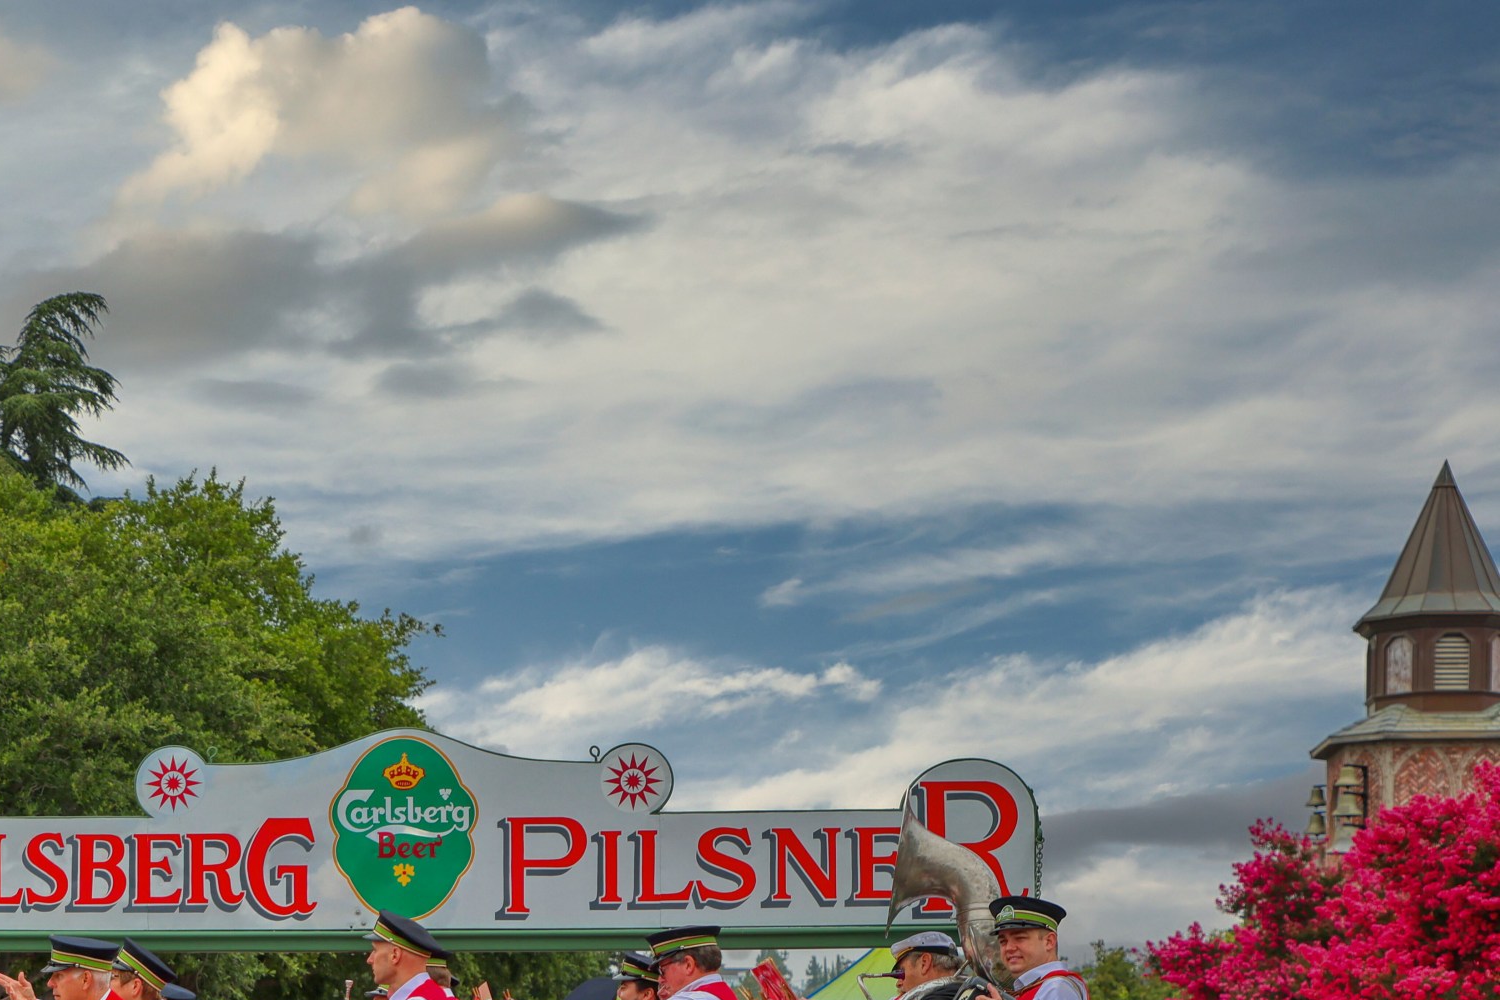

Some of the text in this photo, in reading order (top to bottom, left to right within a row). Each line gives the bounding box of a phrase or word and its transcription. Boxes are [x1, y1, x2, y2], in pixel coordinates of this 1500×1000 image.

[337, 788, 471, 832] Carlsberg
[377, 831, 443, 859] Beer
[495, 779, 1030, 921] PILSNER
